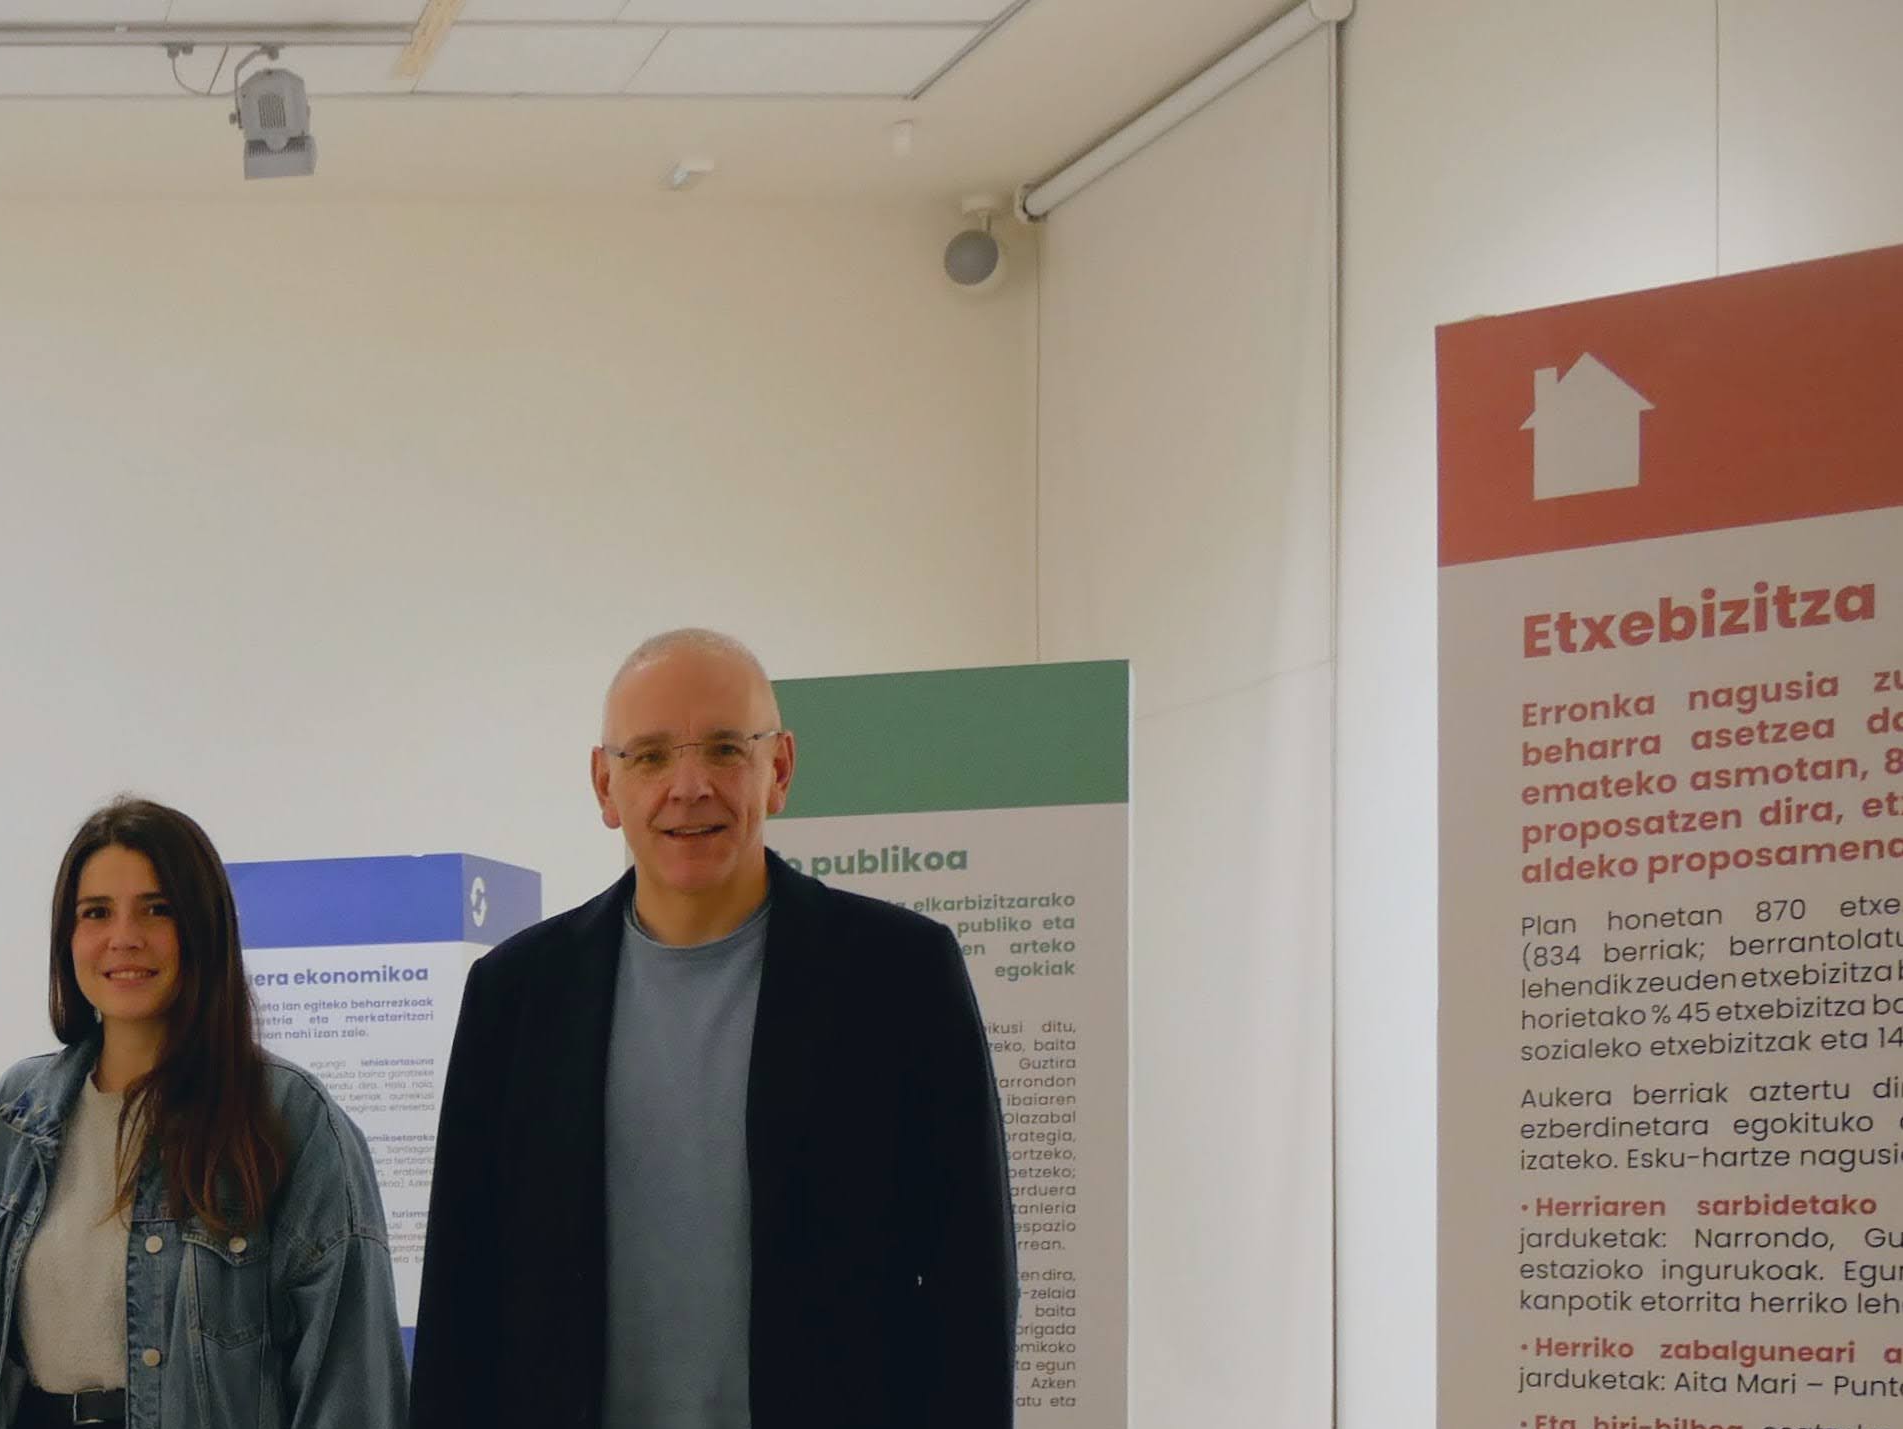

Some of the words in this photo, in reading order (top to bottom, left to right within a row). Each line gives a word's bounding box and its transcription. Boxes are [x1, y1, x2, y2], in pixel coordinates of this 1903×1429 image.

[1524, 581, 1875, 658] Etxebizitza
[1522, 693, 1655, 728] Erronka
[1689, 671, 1839, 715] nagusia
[1522, 734, 1661, 766] beharra
[1691, 718, 1835, 750] asetzea
[1521, 770, 1677, 805] emateko
[1690, 757, 1868, 791] asmotan,
[1522, 809, 1742, 854] proposatzen
[1759, 796, 1843, 826] dira,
[811, 845, 968, 876] publikoa
[1522, 853, 1638, 884] aldeko
[915, 892, 1075, 912] elkarbizitzarako
[957, 916, 1032, 938] publiko
[1042, 916, 1075, 930] eta
[1522, 915, 1576, 936] Plan
[1608, 907, 1722, 931] honetan
[1756, 899, 1806, 923] 870
[1010, 938, 1076, 954] arteko
[1523, 942, 1581, 972] (834
[1604, 937, 1705, 963] berriak;
[293, 965, 428, 985] ekonomikoa
[994, 960, 1075, 982] egokiak
[1522, 973, 1632, 999] lehendik
[1636, 969, 1736, 993] zeuden
[1741, 961, 1892, 988] etxebizitza
[303, 999, 348, 1013] egiteko
[350, 997, 433, 1009] beharrezkoak
[1522, 1005, 1646, 1030] horietako
[1651, 1004, 1671, 1024] %
[1676, 1001, 1710, 1023] 45
[1716, 996, 1865, 1022] etxebizitza
[309, 1015, 329, 1024] eta
[1041, 1020, 1076, 1034] ditu,
[284, 1028, 311, 1039] nahi
[314, 1028, 339, 1038] izan
[1034, 1038, 1076, 1052] baita
[1521, 1037, 1642, 1061] sozialeko
[1650, 1030, 1811, 1056] etxebizitzak
[1821, 1030, 1868, 1050] eta
[1019, 1057, 1076, 1070] Guztira
[1007, 1093, 1076, 1106] ibaiaren
[1521, 1087, 1611, 1108] Aukera
[1633, 1082, 1728, 1105] berriak
[1750, 1080, 1850, 1102] aztertu
[1520, 1116, 1708, 1139] ezberdinetara
[1733, 1111, 1874, 1142] egokituko
[1521, 1149, 1618, 1170] izateko.
[1628, 1147, 1790, 1169] Esku-hartze
[1536, 1195, 1666, 1217] Herriaren
[1697, 1193, 1877, 1216] sarbidetako
[1518, 1227, 1666, 1254] jarduketak:
[1695, 1227, 1834, 1251] Narrondo,
[1520, 1258, 1643, 1280] estazioko
[1662, 1259, 1824, 1287] ingurukoak.
[1034, 1304, 1076, 1317] baita
[1520, 1289, 1632, 1317] kanpotik
[1641, 1291, 1740, 1313] etorrita
[1750, 1291, 1847, 1314] herriko
[1536, 1336, 1634, 1358] Herriko
[1660, 1339, 1855, 1368] zabalguneari
[1035, 1360, 1076, 1375] egun
[1518, 1366, 1665, 1393] jarduketak:
[1674, 1371, 1727, 1393] Aita
[1737, 1373, 1796, 1394] Mari
[1030, 1377, 1076, 1389] Azken
